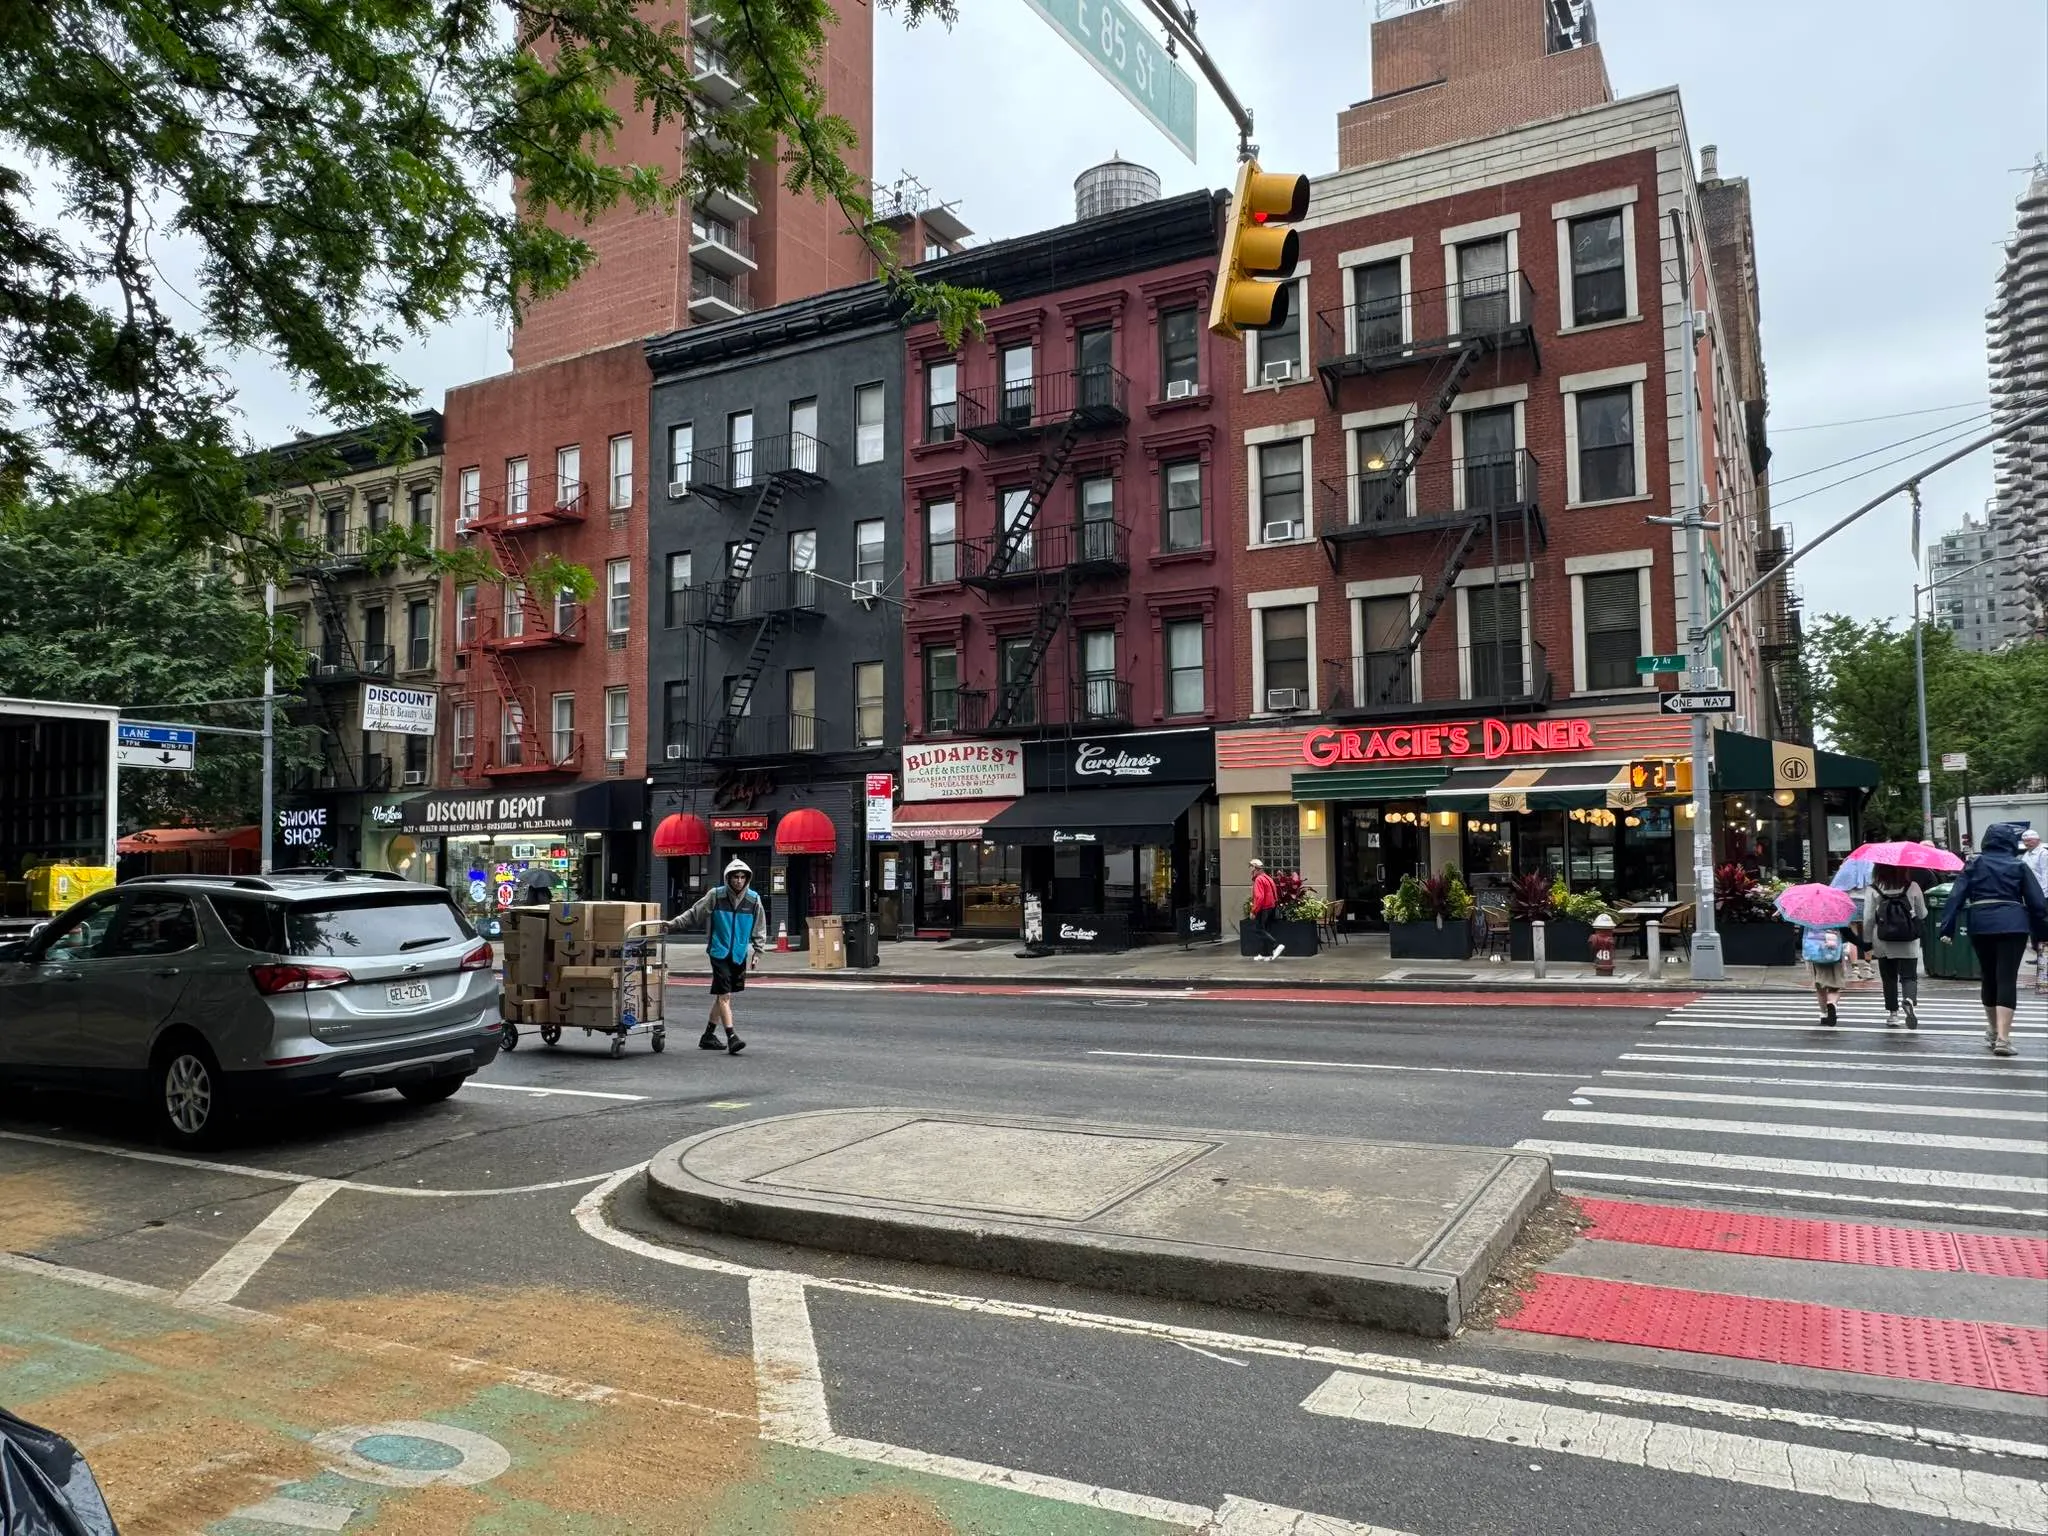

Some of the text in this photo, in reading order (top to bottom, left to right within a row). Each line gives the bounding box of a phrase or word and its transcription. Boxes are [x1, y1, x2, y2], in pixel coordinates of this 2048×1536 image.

[1077, 0, 1155, 101] E 85 St
[1652, 656, 1671, 671] 2 Av
[368, 688, 433, 706] DISCOUNT
[1671, 697, 1726, 708] ONE WAY
[122, 728, 150, 738] LANE
[1302, 718, 1594, 767] GRACIE'S DINER
[906, 745, 1019, 771] BUDAPEST
[1075, 743, 1161, 775] Caroline's
[1653, 766, 1663, 787] 2
[278, 808, 327, 827] SMOKE
[426, 796, 546, 822] DISCOUNT DEPOT
[284, 827, 321, 845] SHOP
[1370, 833, 1378, 844] A
[390, 987, 405, 1001] GEL
